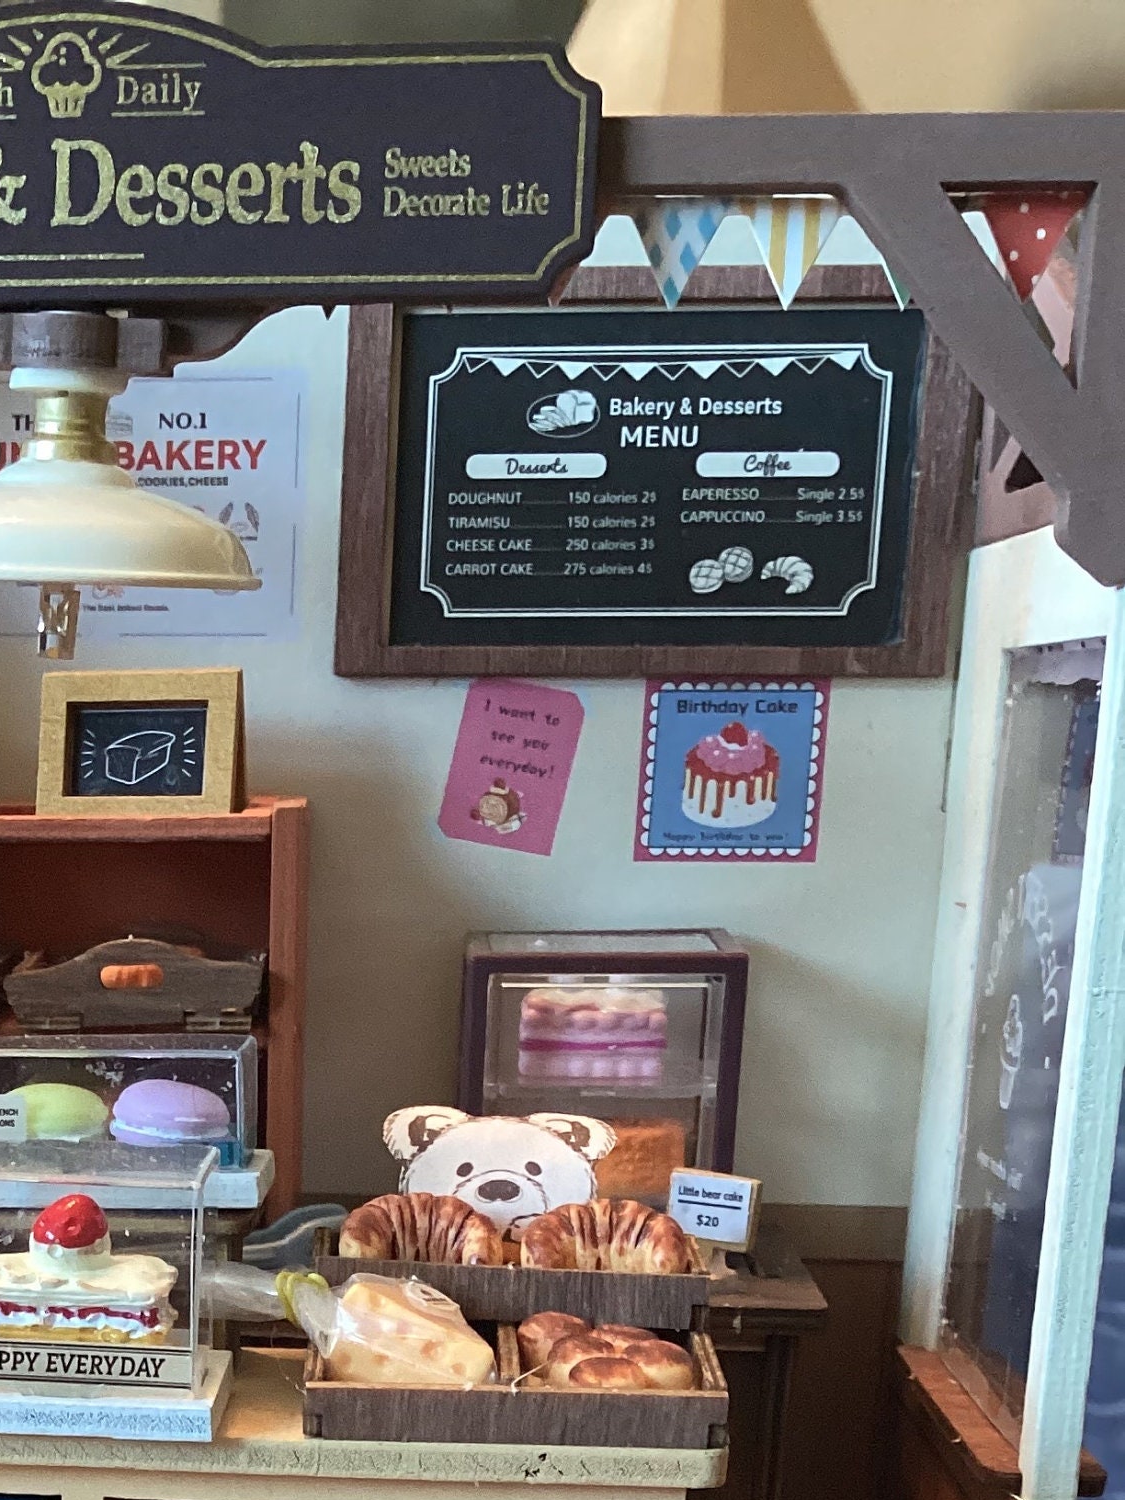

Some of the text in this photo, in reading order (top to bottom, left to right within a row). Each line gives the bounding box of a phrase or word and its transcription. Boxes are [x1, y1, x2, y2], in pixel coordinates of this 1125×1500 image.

[117, 76, 201, 105] Daily
[384, 147, 471, 179] Sweets
[50, 137, 361, 227] Desserts
[383, 183, 550, 218] Decorate Life
[609, 396, 782, 421] Bakery & Desserts
[12, 412, 208, 431] TH NO.1
[620, 425, 699, 448] MENU
[112, 439, 267, 472] BAKERY
[743, 454, 792, 476] Coffee
[505, 459, 569, 475] Desserts
[448, 492, 523, 505] DOUGHNUT
[568, 491, 591, 504] 150
[593, 491, 638, 504] calories
[797, 487, 835, 503] Single
[448, 516, 511, 529] TIRAMISU
[567, 515, 589, 529] 150
[592, 516, 637, 529] calories
[680, 510, 766, 523] CAPPUCCINO
[795, 509, 833, 525] Single
[446, 539, 495, 552] CHEESE
[499, 539, 533, 552] CAKE
[591, 538, 636, 552] calories
[445, 563, 497, 575] CARROT
[500, 563, 534, 576] CAKE
[563, 562, 587, 575] 275
[589, 562, 634, 575] calories
[499, 705, 535, 721] want
[545, 714, 560, 726] to
[677, 699, 799, 716] Birthday Cake
[491, 730, 550, 751] see you
[678, 1185, 700, 1197] Little
[702, 1188, 722, 1200] bear
[696, 1214, 719, 1228] $20
[45, 1352, 166, 1378] EVERYDAY
